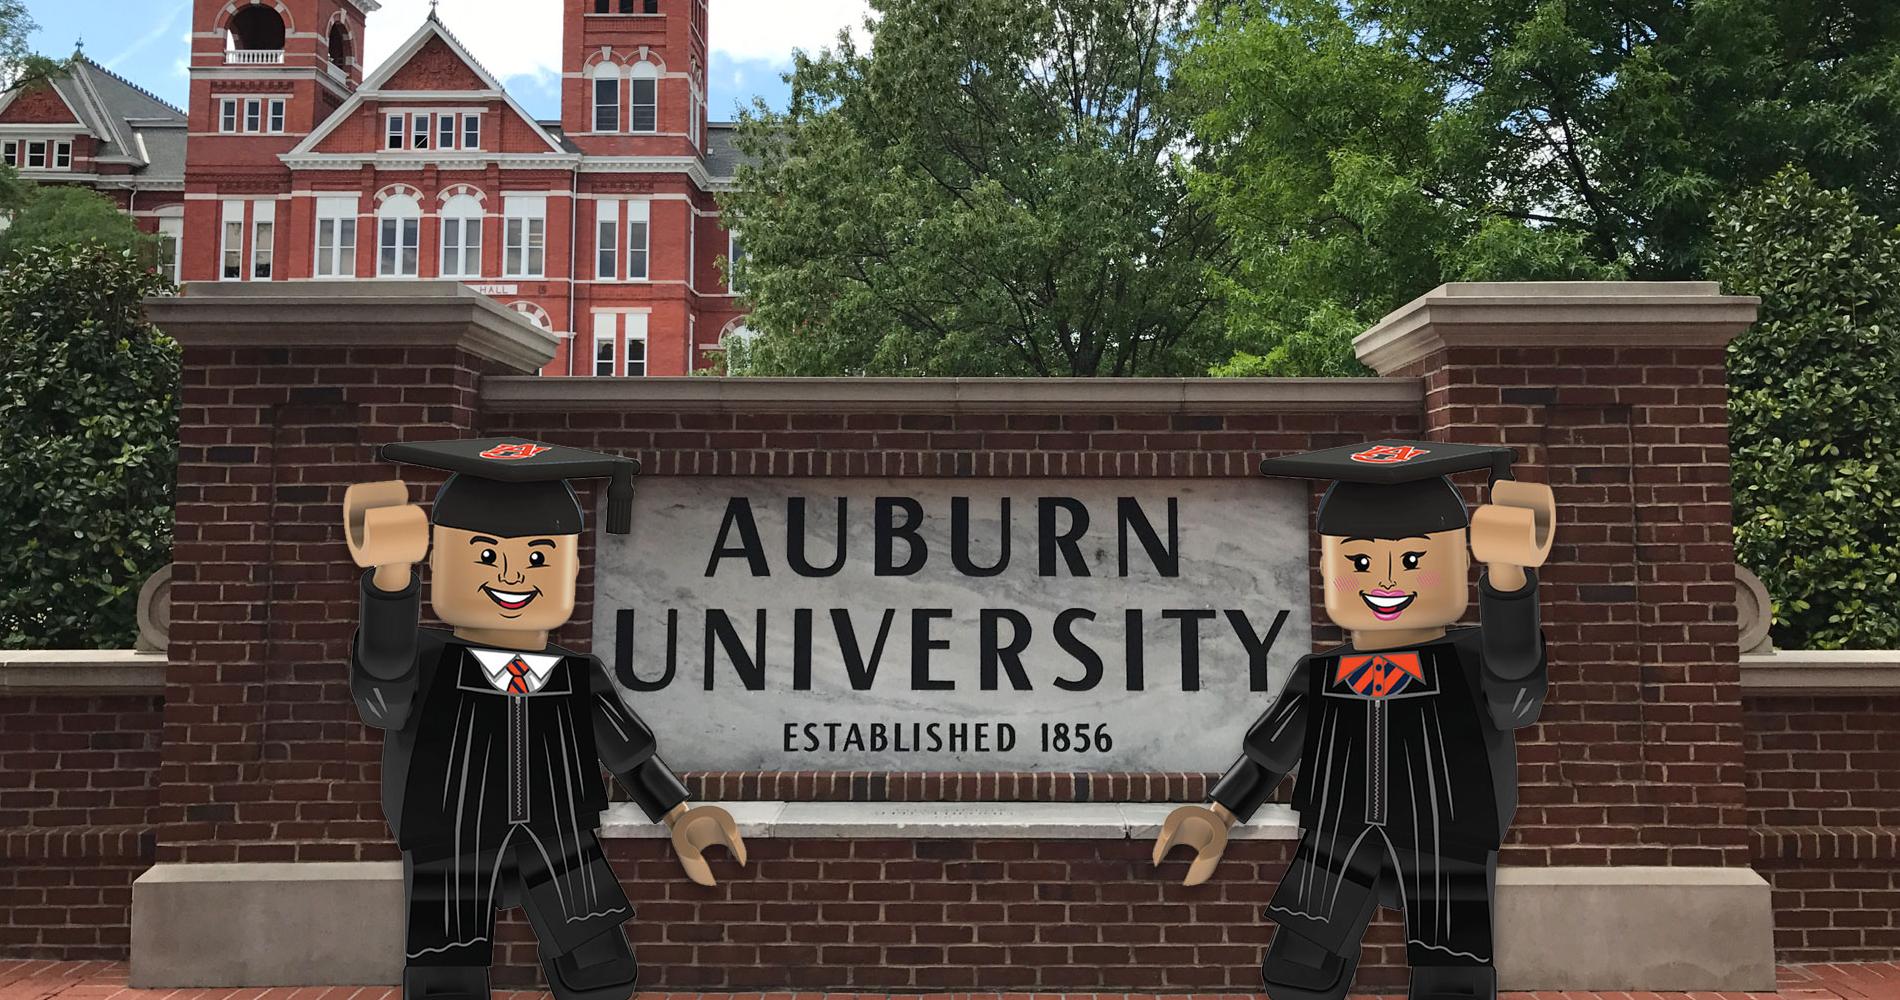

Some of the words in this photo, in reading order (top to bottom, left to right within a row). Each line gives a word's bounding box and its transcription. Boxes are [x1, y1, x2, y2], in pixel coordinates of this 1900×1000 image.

[480, 286, 508, 294] HALL
[704, 495, 1180, 578] AUBURN
[614, 607, 1291, 693] UNIVERSITY
[783, 722, 1016, 753] ESTABLISHED
[1041, 722, 1113, 754] 1856
